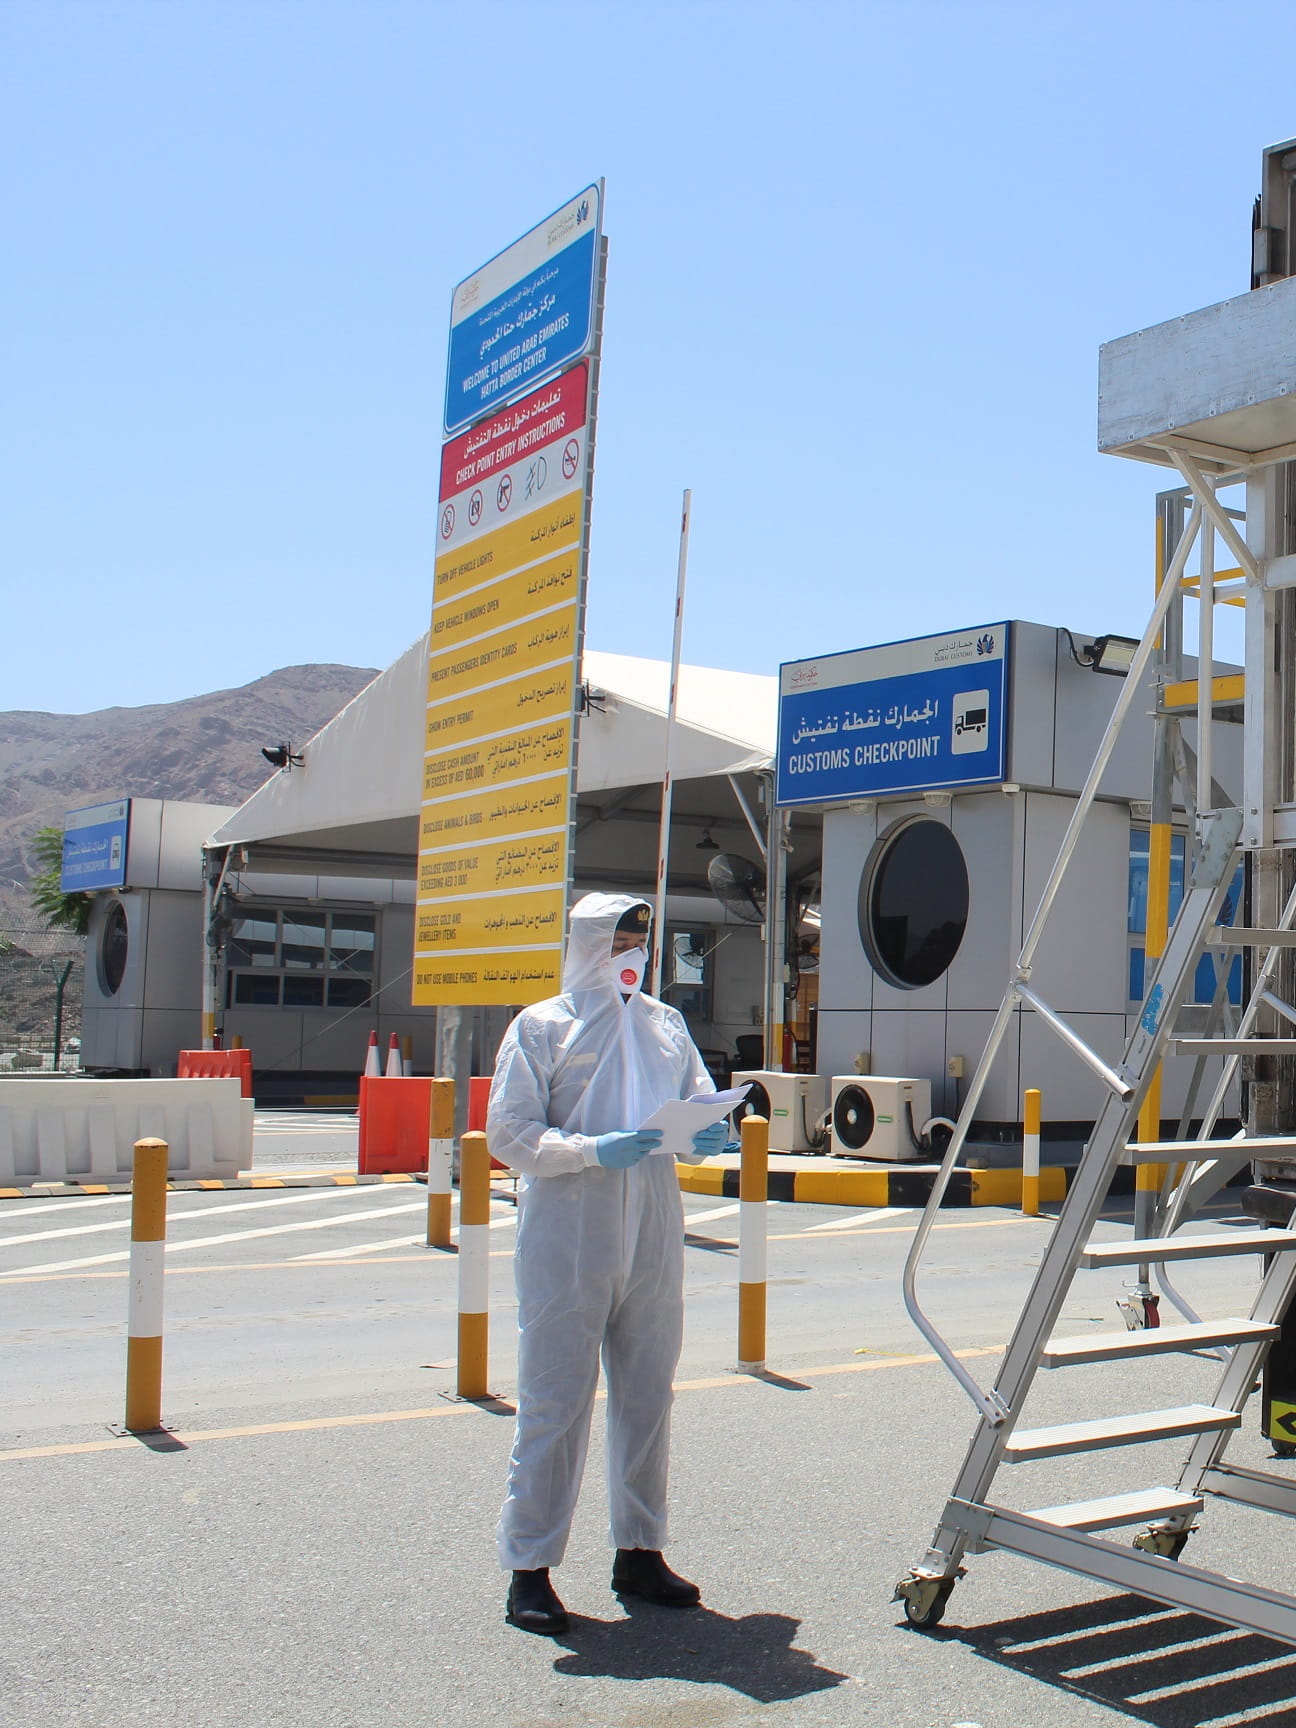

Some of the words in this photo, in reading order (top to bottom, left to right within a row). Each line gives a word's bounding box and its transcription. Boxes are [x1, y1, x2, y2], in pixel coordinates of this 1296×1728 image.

[463, 364, 490, 393] WELCOME
[491, 359, 499, 375] TO
[499, 345, 521, 370] UNITED
[521, 334, 538, 356] ARAB
[539, 312, 570, 344] EMIRATES
[480, 377, 499, 400] HATTA
[500, 362, 522, 388] BORDER
[523, 346, 547, 373] CENTER
[531, 387, 561, 417] تعليمات
[492, 417, 512, 439] نقطة
[511, 408, 530, 432] دخول
[456, 460, 476, 485] CHECK
[476, 452, 496, 474] POINT
[496, 439, 517, 464] ENTRY
[517, 411, 566, 452] INSTRUCTIONS
[437, 570, 449, 585] TURN
[449, 567, 458, 580] OFF
[458, 559, 476, 577] VEHICLE
[476, 551, 494, 568] LIGHTS
[433, 620, 445, 634] KEEP
[445, 612, 463, 629] VEHICLE
[464, 604, 486, 622] WINDOWS
[487, 599, 500, 615] OPEN
[431, 667, 450, 683] PRESENT
[450, 656, 479, 675] PASSENGERS
[480, 649, 501, 666] IDENTITY
[501, 642, 518, 658] CARDS
[428, 722, 441, 734] SHOW
[442, 716, 456, 730] ENTRY
[456, 710, 474, 724] PERMIT
[841, 708, 881, 733] نقطة
[884, 699, 940, 730] الجمارك
[792, 715, 839, 745] تفتيش
[426, 760, 447, 775] DISCLOSE
[447, 756, 460, 770] CASH
[460, 751, 479, 766] AMOUNT
[788, 747, 850, 775] CUSTOMS
[854, 735, 941, 766] CHECKPOINT
[431, 774, 448, 789] EXCESS
[454, 770, 465, 783] AED
[423, 820, 443, 834] DISCLOSE
[443, 815, 464, 829] ANIMALS
[469, 811, 483, 824] BIRDS
[421, 862, 442, 876] DISCLOSE
[442, 860, 457, 874] GOODS
[464, 856, 479, 870] VALUE
[421, 877, 444, 891] EXCEEDING
[444, 875, 453, 888] AED
[419, 914, 440, 927] DISCLOSE
[440, 913, 452, 925] GOLD
[452, 912, 462, 924] AND
[418, 929, 442, 942] JEWELLERY
[442, 928, 457, 940] ITEMS
[416, 973, 423, 985] DO
[423, 973, 432, 985] NOT
[432, 973, 442, 985] USE
[442, 972, 459, 984] MOBILE
[459, 971, 477, 984] PHONES
